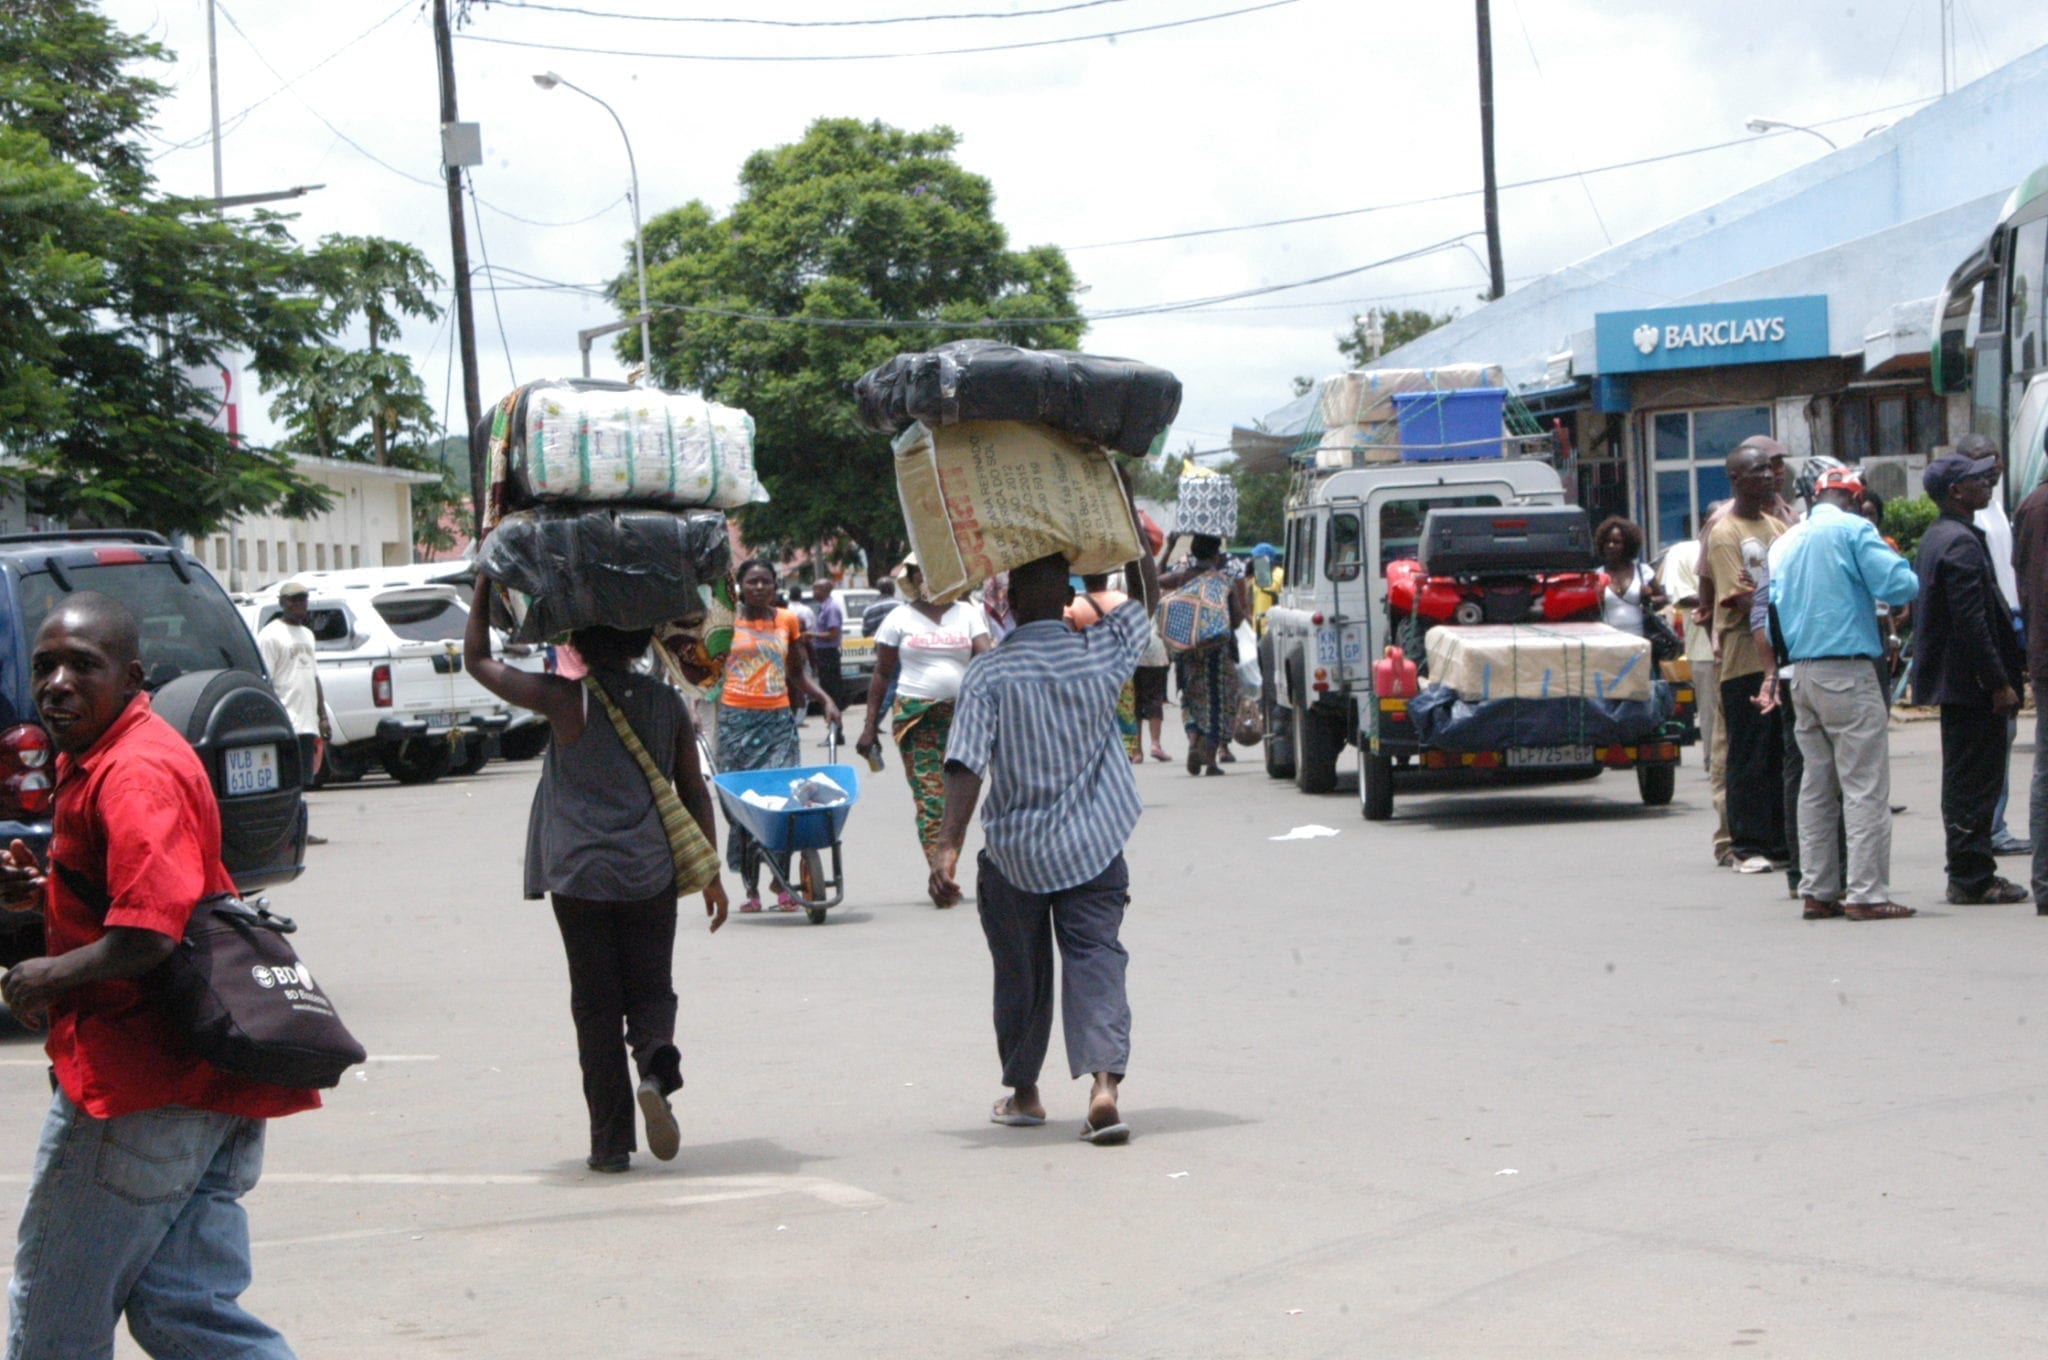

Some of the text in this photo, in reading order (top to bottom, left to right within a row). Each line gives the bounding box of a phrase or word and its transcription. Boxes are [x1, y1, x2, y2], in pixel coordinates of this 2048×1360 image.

[1665, 317, 1786, 349] BARCLAYS
[970, 435, 988, 495] REFINADO
[990, 469, 1001, 486] DO
[1002, 464, 1016, 490] 2012
[982, 499, 1001, 529] CANA
[1079, 496, 1089, 515] Box
[994, 531, 1006, 547] DE
[1344, 644, 1360, 659] GP
[228, 751, 253, 769] VLB
[230, 767, 273, 791] 610 GP
[271, 966, 299, 985] BD
